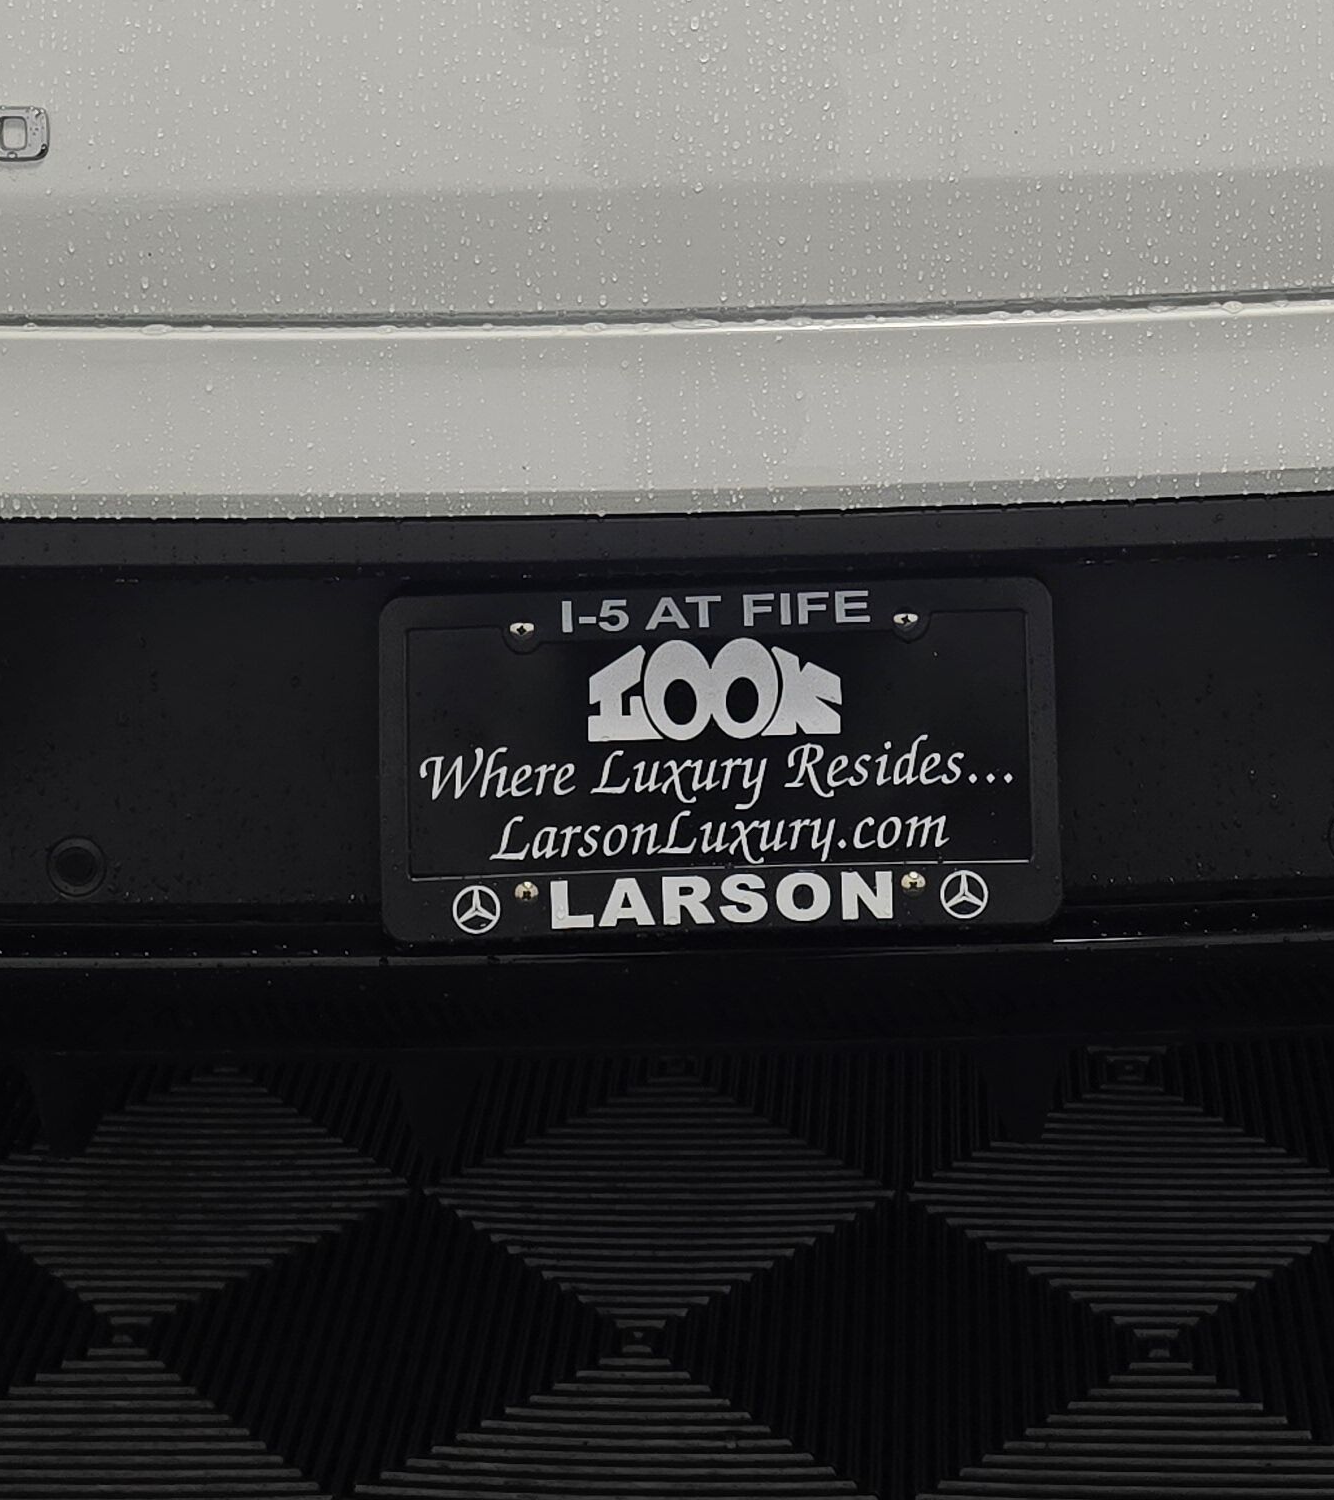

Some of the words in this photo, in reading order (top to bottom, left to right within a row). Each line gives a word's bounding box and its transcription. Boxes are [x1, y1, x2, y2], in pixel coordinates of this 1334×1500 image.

[561, 599, 630, 633] I-5
[645, 595, 722, 631] AT
[742, 590, 871, 627] FIFE
[587, 637, 843, 742] LOOK
[419, 746, 577, 801] Where
[590, 749, 768, 810] Luxury
[784, 734, 1014, 798] Resides...
[489, 810, 951, 865] LarsonLuxury.com
[550, 870, 895, 930] LARSON
